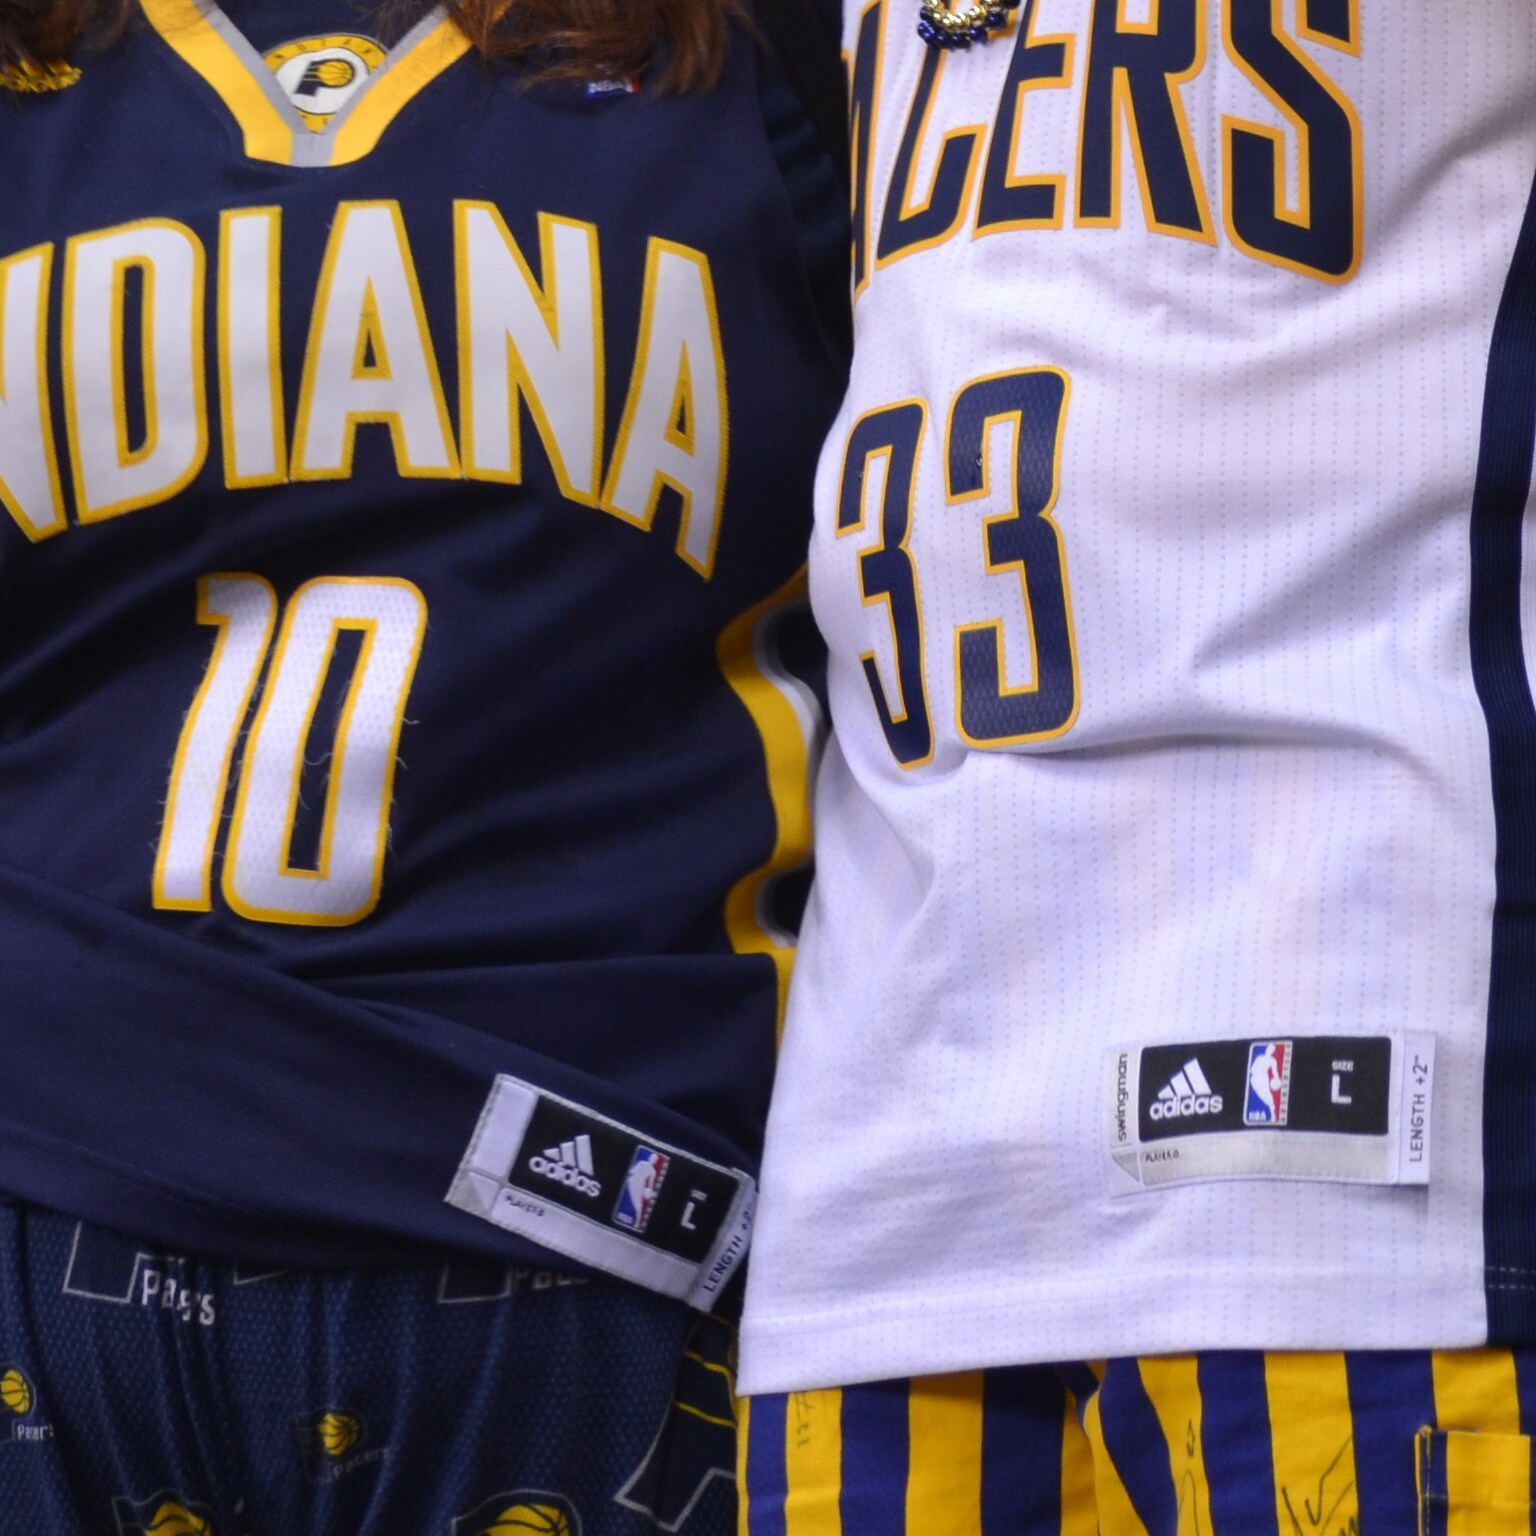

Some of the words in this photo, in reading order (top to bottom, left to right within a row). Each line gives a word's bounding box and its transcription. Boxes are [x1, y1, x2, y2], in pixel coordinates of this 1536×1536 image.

[836, 364, 1080, 769] 33
[152, 571, 427, 926] 10
[1117, 1053, 1129, 1142] swingman
[1149, 1093, 1223, 1121] adidas
[1331, 1075, 1352, 1104] L
[1409, 1093, 1423, 1163] LENGTH
[528, 1156, 601, 1197] adidas
[680, 1202, 696, 1230] L
[703, 1235, 743, 1293] LENGTH
